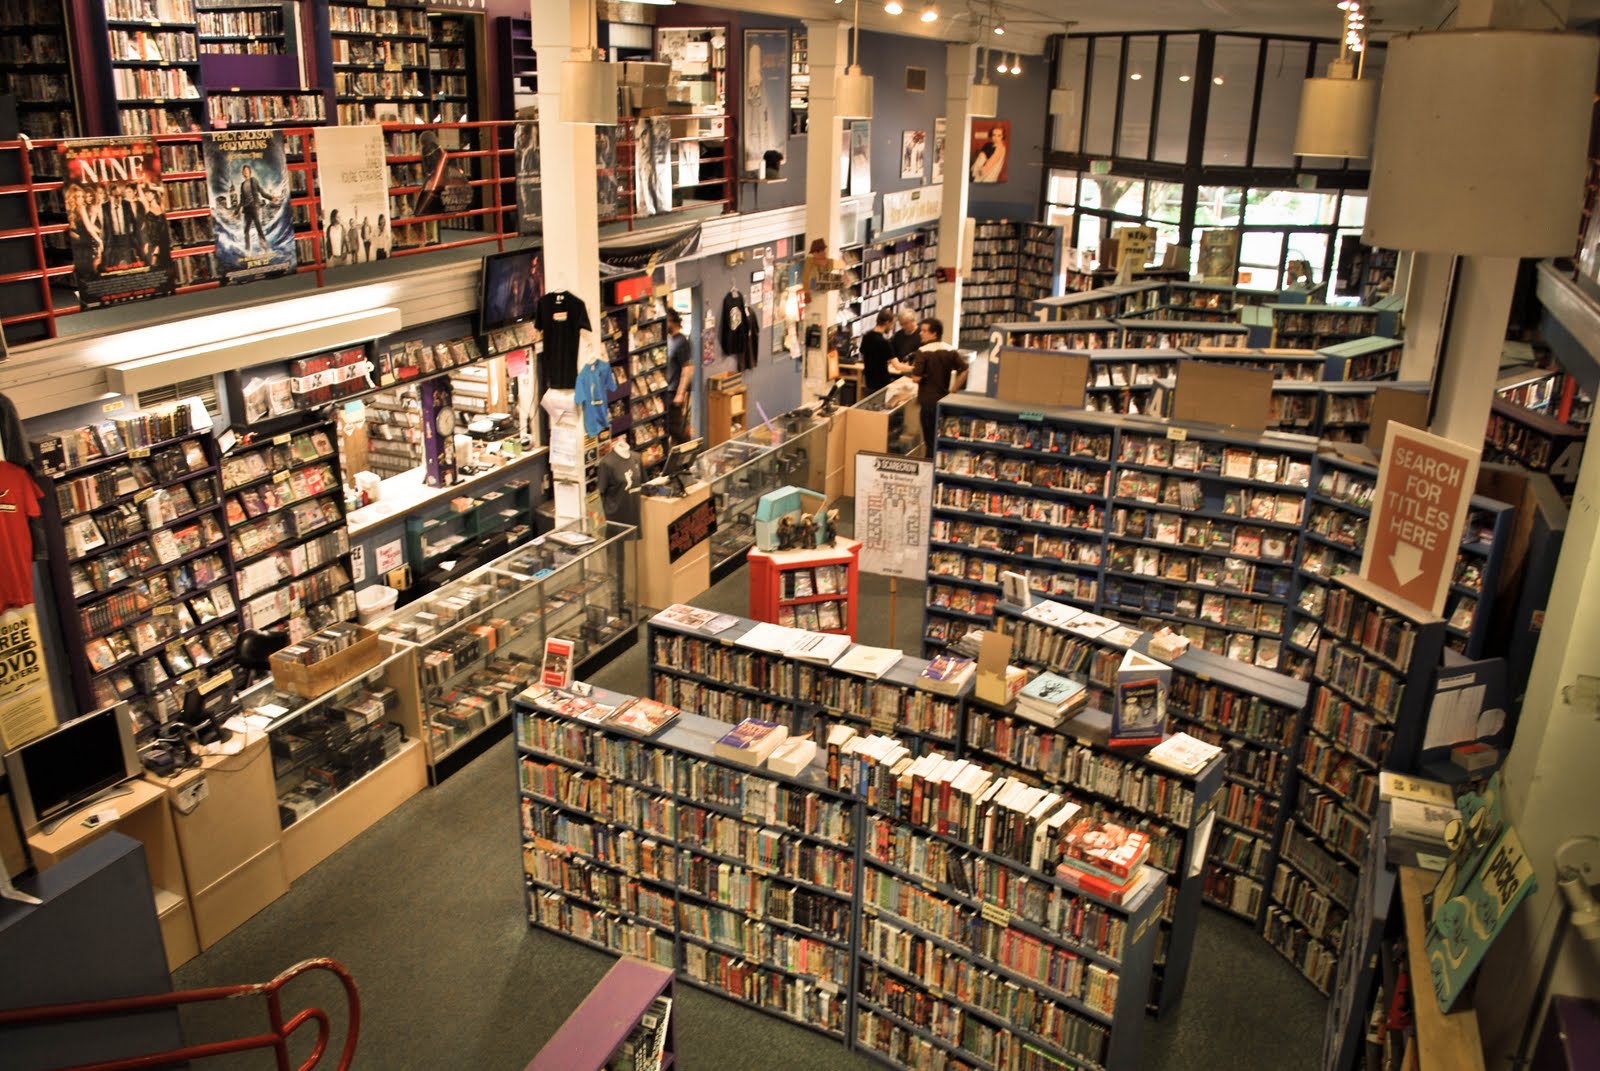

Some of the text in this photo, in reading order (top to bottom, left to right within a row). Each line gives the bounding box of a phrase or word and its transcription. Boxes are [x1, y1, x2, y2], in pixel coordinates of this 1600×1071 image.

[211, 130, 274, 142] PERCY JACKSON
[79, 156, 146, 183] NINE
[1034, 307, 1049, 322] 1
[990, 331, 1003, 364] 2
[1149, 388, 1163, 417] 4
[1395, 447, 1460, 487] SEARCH
[1406, 474, 1442, 504] FOR
[1388, 491, 1450, 531] TITLES
[1389, 515, 1438, 551] HERE
[0, 619, 28, 636] GION
